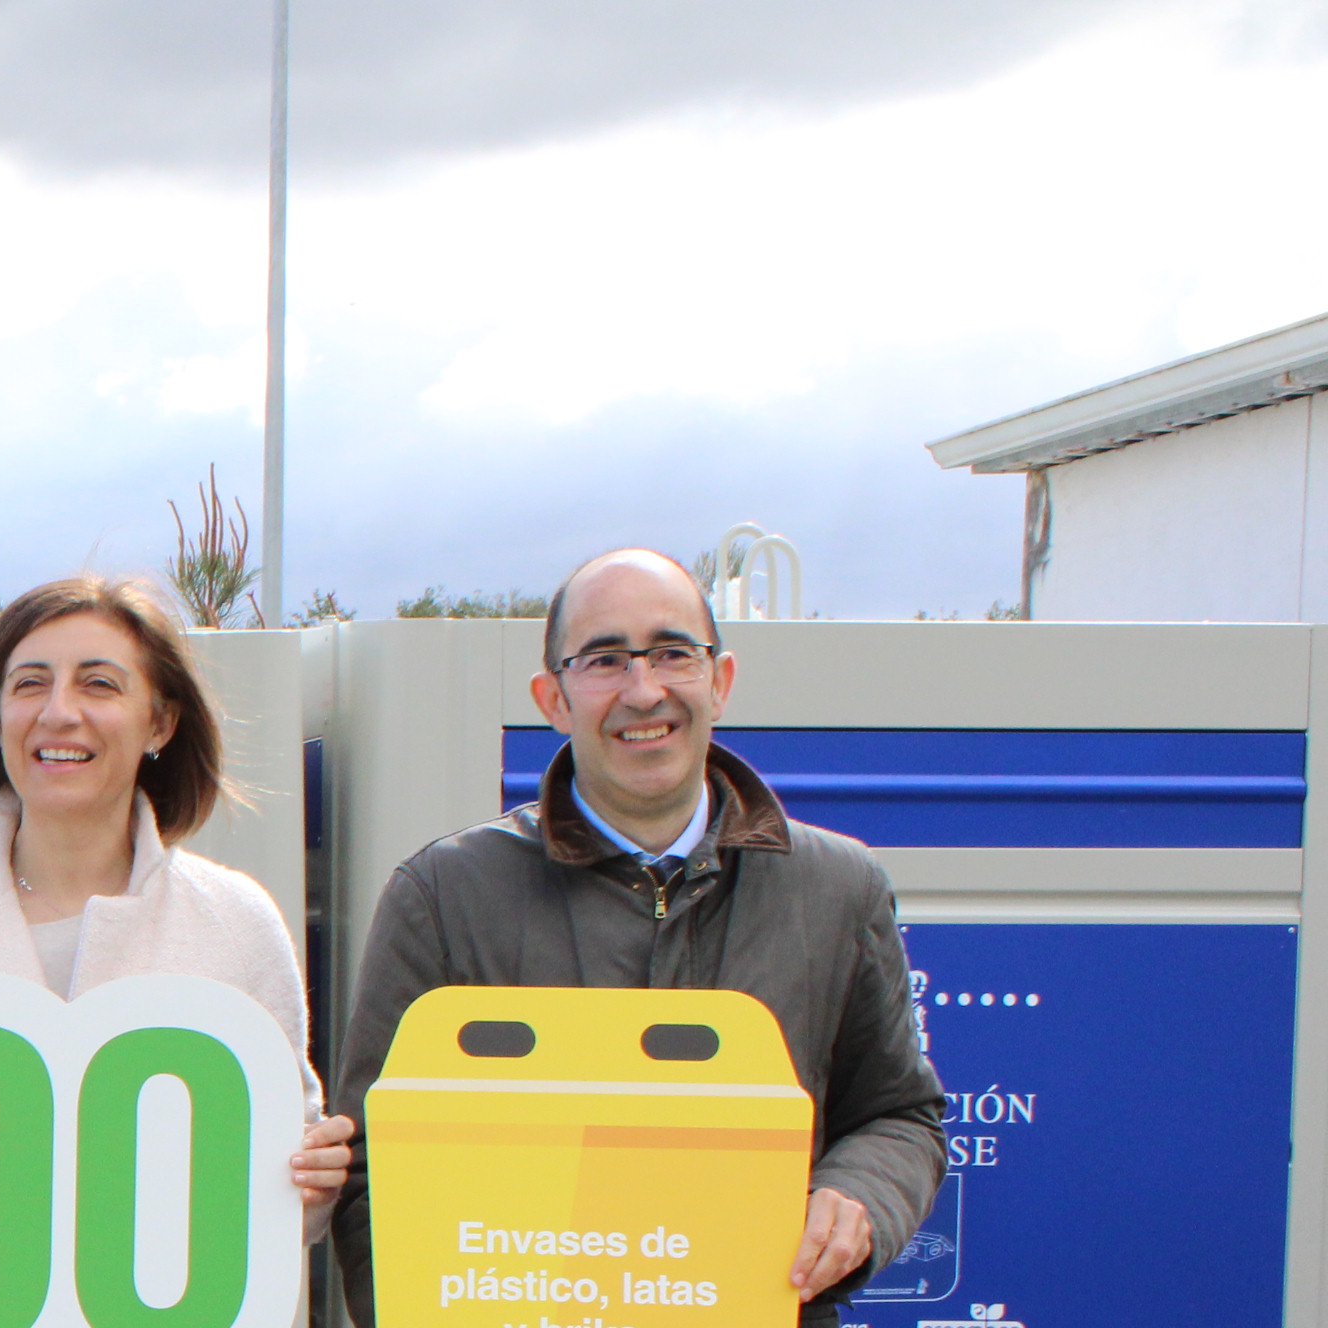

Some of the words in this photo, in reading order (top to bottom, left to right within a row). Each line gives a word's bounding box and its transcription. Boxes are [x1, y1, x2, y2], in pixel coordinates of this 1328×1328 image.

[457, 1220, 629, 1258] Envases
[640, 1226, 690, 1259] de
[440, 1266, 610, 1310] plástico,
[622, 1271, 718, 1306] latas
